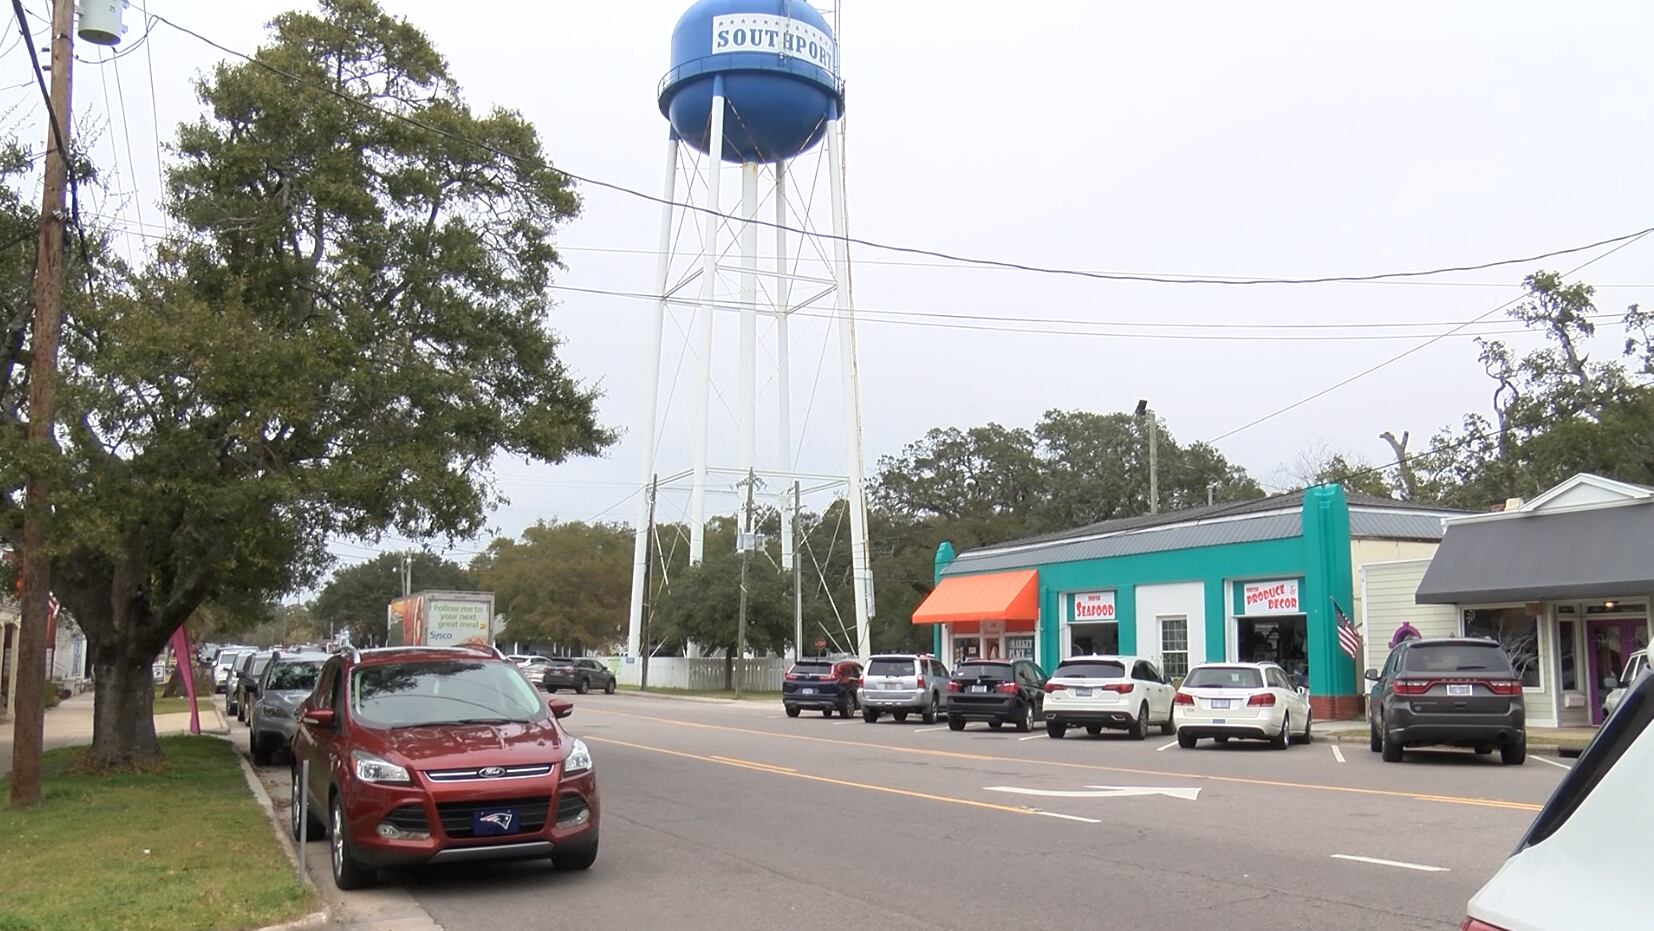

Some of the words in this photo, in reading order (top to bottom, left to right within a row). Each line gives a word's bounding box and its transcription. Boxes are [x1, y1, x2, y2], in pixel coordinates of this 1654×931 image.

[717, 28, 833, 70] SOUTHPORT
[1246, 584, 1285, 605] PRODUCE
[433, 604, 459, 613] Follow
[474, 605, 484, 613] to
[1268, 597, 1297, 609] DECOR
[438, 621, 458, 629] great
[430, 630, 453, 640] Sysco
